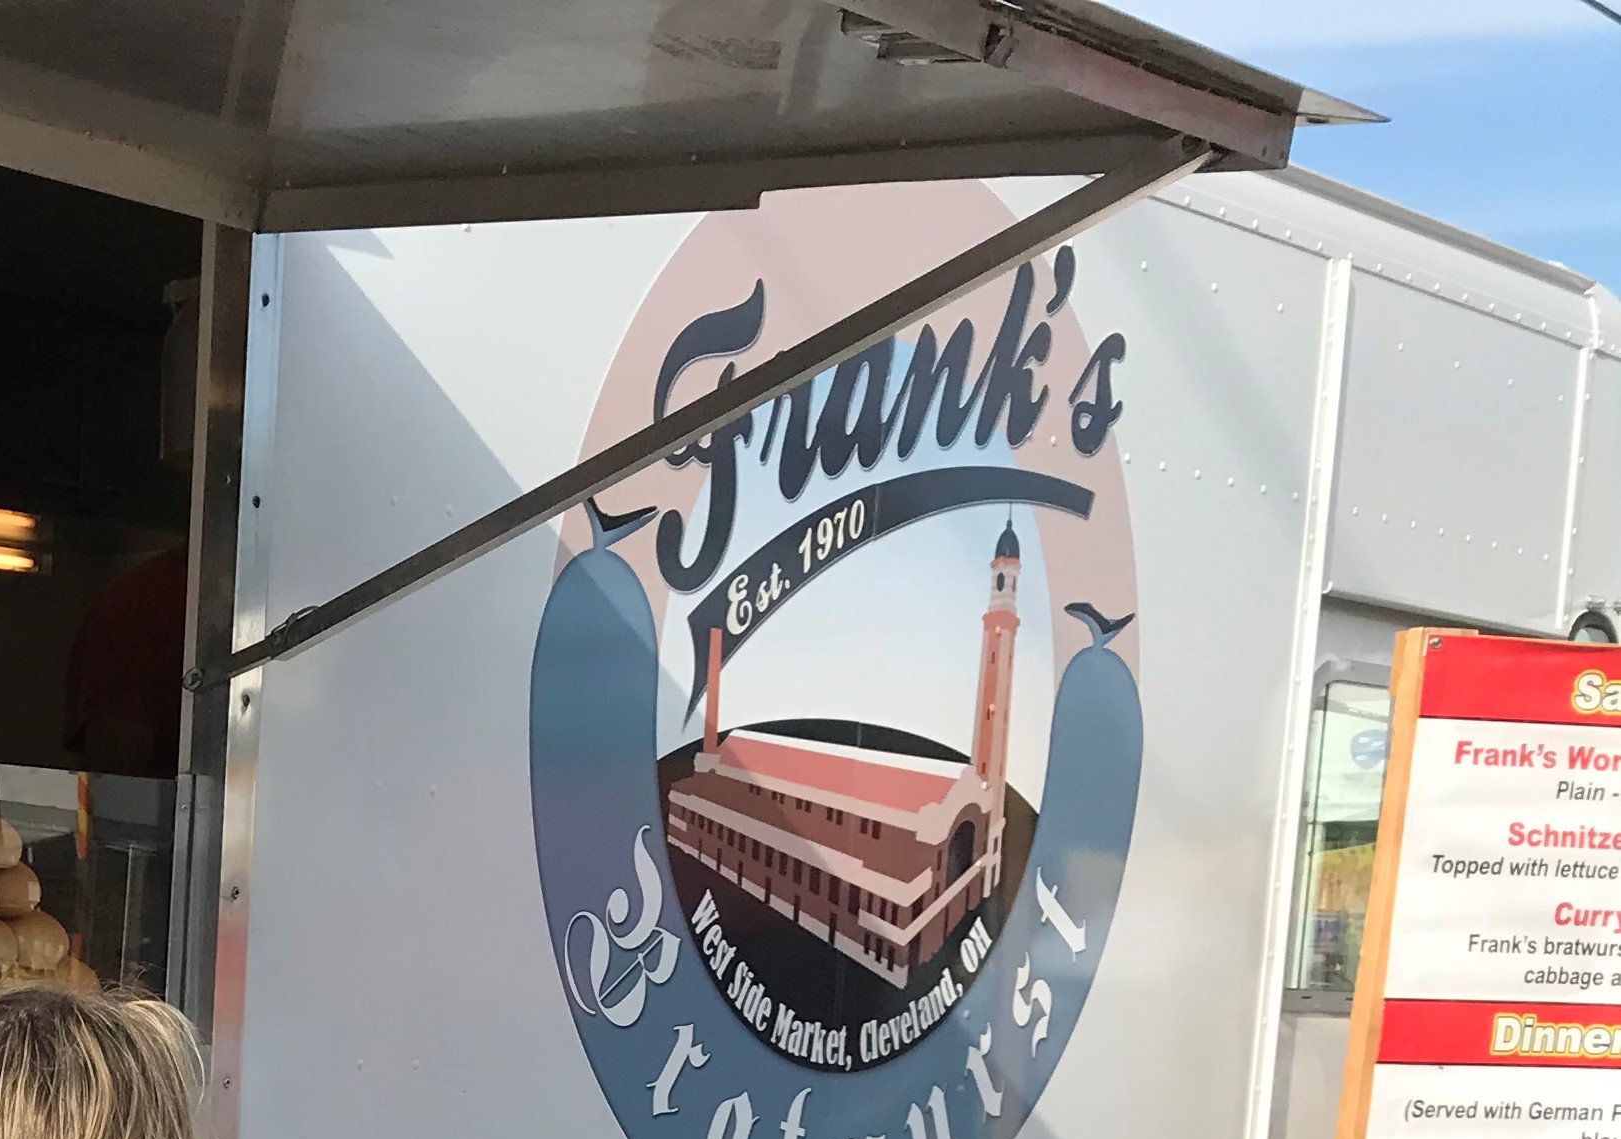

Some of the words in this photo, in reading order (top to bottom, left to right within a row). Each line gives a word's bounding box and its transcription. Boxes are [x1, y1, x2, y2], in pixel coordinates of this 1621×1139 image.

[654, 244, 1125, 594] Frank's
[726, 575, 790, 635] Est.
[798, 499, 867, 573] 1970
[1454, 740, 1557, 769] Frank's
[1556, 781, 1605, 802] Plain
[1432, 853, 1504, 881] Topped
[1510, 858, 1549, 878] with
[1555, 859, 1619, 879] lettuce
[1468, 934, 1538, 955] Frank's
[691, 888, 737, 981] West
[727, 961, 772, 1032] Side
[770, 1002, 853, 1072] Market,
[860, 967, 964, 1064] Cleveland,
[960, 916, 994, 974] OH
[1524, 965, 1604, 990] cabbage
[1404, 1100, 1477, 1123] (Served
[1483, 1101, 1521, 1121] with
[1529, 1101, 1604, 1121] German
